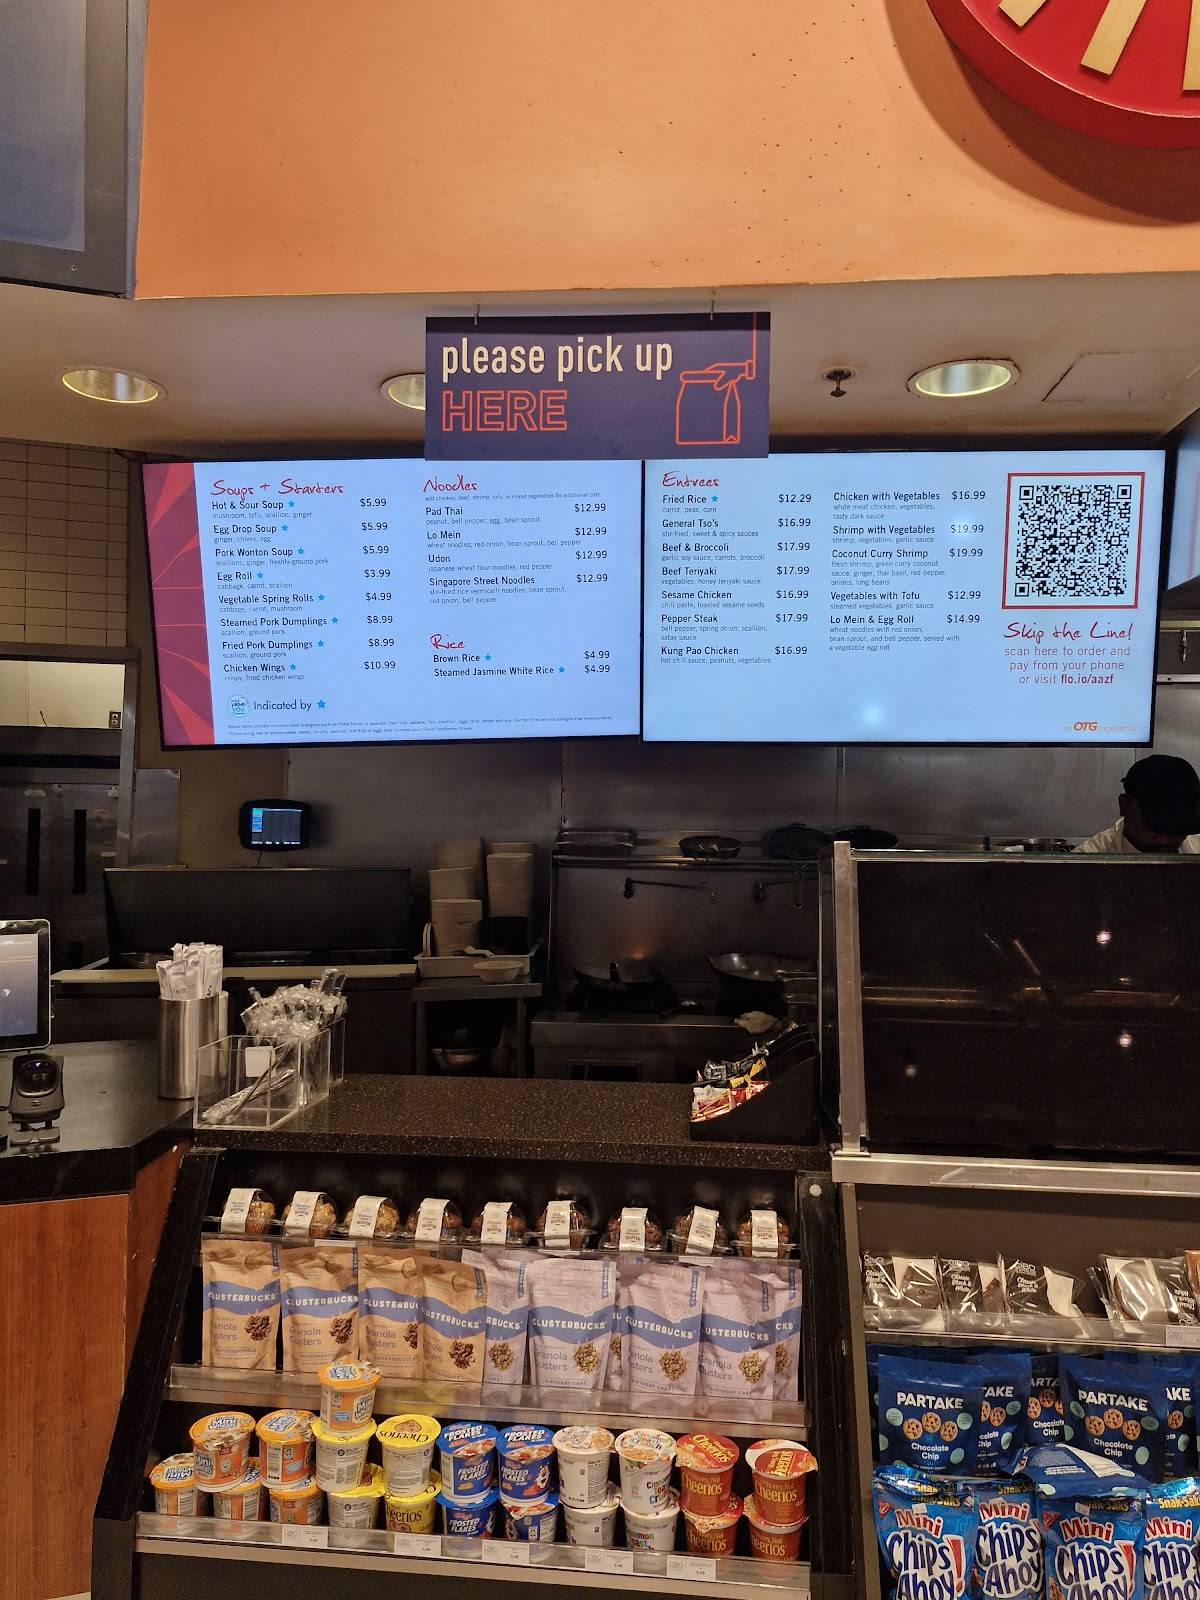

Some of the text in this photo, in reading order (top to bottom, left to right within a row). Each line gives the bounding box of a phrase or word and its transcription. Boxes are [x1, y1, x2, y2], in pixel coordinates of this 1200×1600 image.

[442, 335, 672, 382] please pick up
[442, 389, 568, 431] HERE
[423, 474, 478, 492] Noodles
[662, 470, 720, 487] Entrees
[210, 479, 255, 499] Soups
[277, 479, 344, 495] Starters
[662, 494, 708, 504] Fried Rice
[778, 493, 812, 504] $12.29
[833, 491, 941, 503] Chicken with Vegetables
[951, 490, 986, 501] $16.99
[211, 500, 284, 511] Hot & Sour Soup
[359, 498, 387, 508] $5.99
[574, 503, 607, 513] $12.99
[425, 506, 463, 516] Pad Thai
[361, 521, 389, 532] $5.99
[662, 518, 719, 528] General Tso's
[777, 517, 812, 528] $16.99
[213, 524, 277, 536] Egg Drop Soup
[574, 526, 608, 537] $12.99
[832, 525, 936, 536] Shrimp with Vegetables
[950, 524, 985, 534] $19.99
[426, 530, 462, 540] Lo Mein
[215, 547, 294, 558] Pork Wonton Soup
[361, 545, 390, 555] $5.99
[662, 543, 729, 552] Beef & Broccoli
[777, 542, 811, 552] $17.99
[428, 554, 451, 563] Udon
[575, 550, 608, 561] $12.99
[831, 549, 929, 560] Coconut Curry Shrimp
[949, 548, 984, 558] $19.99
[364, 568, 391, 579] $3.99
[662, 566, 717, 578] Beef Teriyaki
[776, 566, 810, 576] $17.99
[217, 571, 253, 583] Egg Roll
[429, 576, 536, 588] Singapore Street Noodles
[576, 573, 609, 583] $12.99
[218, 593, 314, 606] Vegetable Spring Rolls
[365, 592, 393, 602] $4.99
[661, 590, 732, 600] Sesame Chicken
[776, 589, 809, 599] $16.99
[830, 591, 920, 602] Vegetables with Tofu
[947, 590, 982, 601] $12.99
[220, 616, 328, 628] Steamed Pork Dumplings
[366, 615, 394, 624] $8.99
[661, 614, 718, 625] Pepper Steak
[775, 613, 809, 623] $17.99
[830, 615, 914, 626] Lo Mein & Egg Roll
[946, 614, 981, 625] $14.99
[1004, 622, 1134, 644] Skip the Line!
[222, 640, 314, 651] Fried Pork Dumplings
[368, 638, 395, 648] $8.99
[430, 634, 466, 649] Rice
[584, 650, 610, 660] $4.99
[661, 646, 739, 657] Kung Pao Chicken
[774, 646, 808, 656] $16.99
[1004, 645, 1131, 657] scan here to order and
[433, 654, 481, 663] Brown Rice
[223, 663, 286, 674] Chicken Wings
[363, 660, 396, 670] $10.99
[584, 664, 611, 674] $4.99
[1009, 659, 1126, 673] pay from your phone
[433, 666, 555, 677] Steamed Jasmine White Rice
[1019, 673, 1115, 685] or visit flo.io/aazf
[253, 699, 298, 711] Indicated
[299, 699, 313, 712] by
[1073, 722, 1098, 731] OTG
[286, 1295, 359, 1306] CLUSTERBUCKS
[532, 1318, 607, 1330] CLUSTERBUCKS
[625, 1315, 694, 1339] CLUSTERBUCKS
[896, 1391, 964, 1410] PARTAKE
[1078, 1389, 1148, 1411] PARTAKE
[379, 1430, 429, 1443] Cheerios
[444, 1425, 483, 1439] FROSTED
[449, 1432, 481, 1442] FLAKES
[692, 1434, 731, 1463] Cheerios
[911, 1442, 949, 1452] Chocolate
[1093, 1437, 1134, 1450] Chocolate
[921, 1451, 940, 1461] Chip
[1104, 1448, 1123, 1457] Chip
[458, 1461, 489, 1475] FROSTED
[460, 1469, 486, 1481] FLAKES
[755, 1482, 798, 1503] Cheerios
[979, 1501, 1030, 1522] Mini
[896, 1509, 943, 1538] Mini
[1061, 1517, 1113, 1542] Mini
[976, 1522, 1040, 1567] Chips
[888, 1530, 951, 1576] Chips
[1057, 1543, 1125, 1588] Chips
